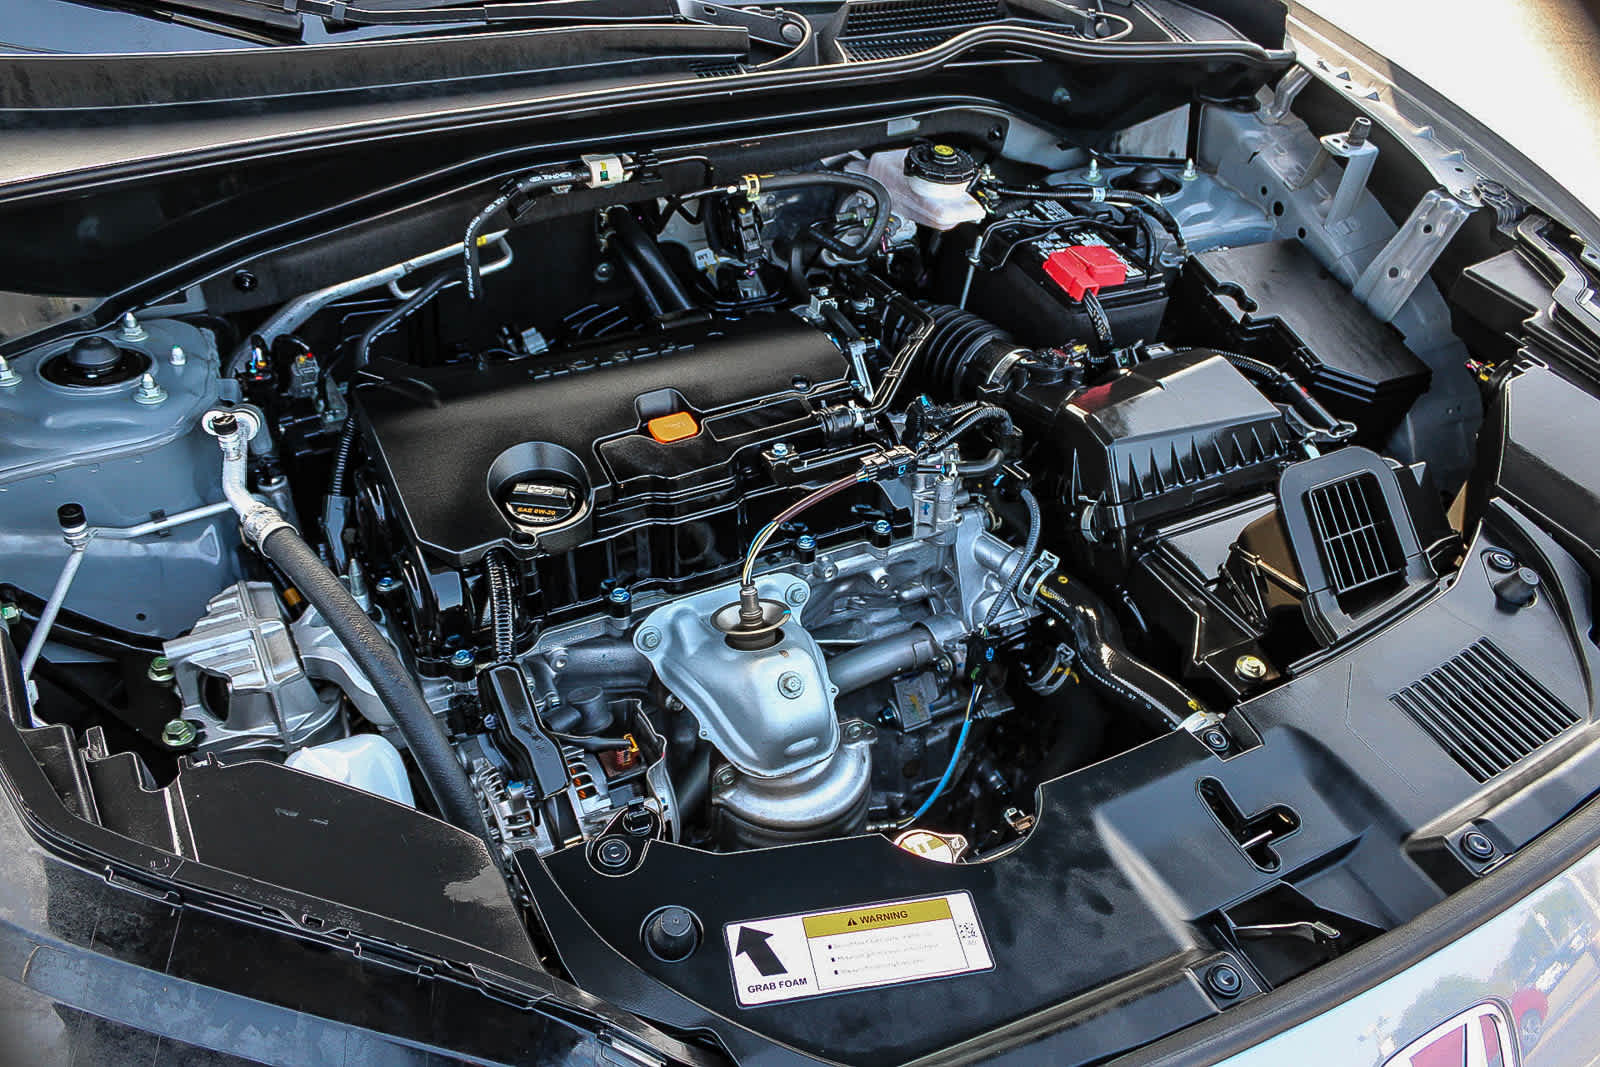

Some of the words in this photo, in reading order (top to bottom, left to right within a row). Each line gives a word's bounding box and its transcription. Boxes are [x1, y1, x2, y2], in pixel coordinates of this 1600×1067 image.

[859, 910, 908, 925] WARNING
[747, 981, 777, 994] GRAB
[779, 977, 808, 989] FOAM
